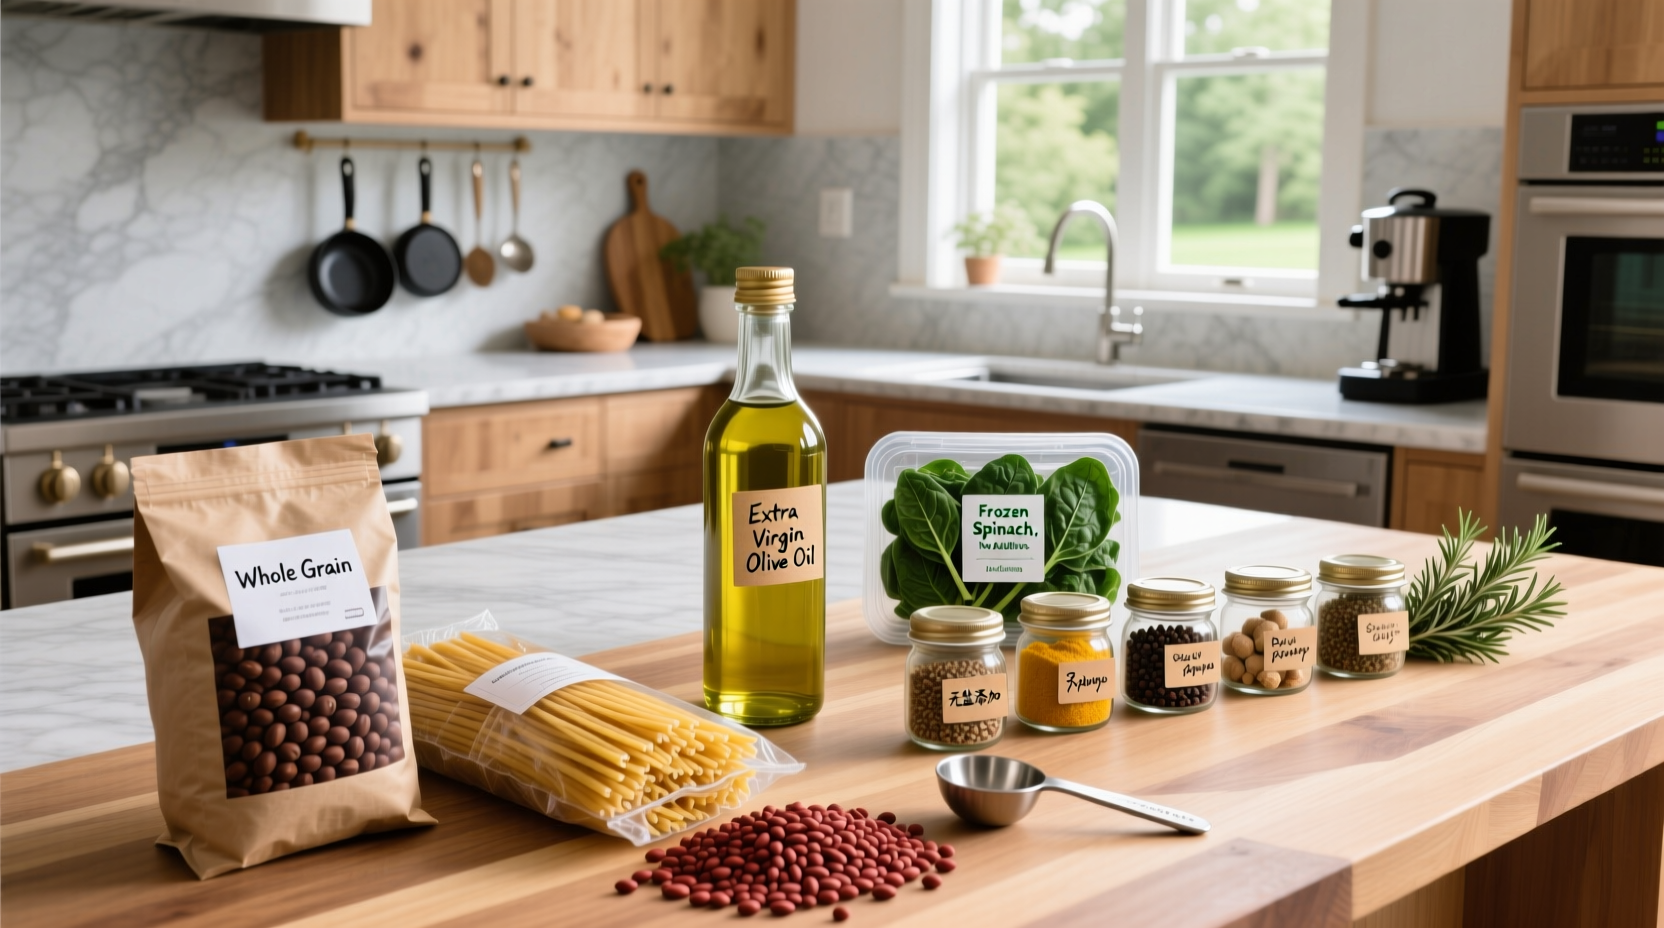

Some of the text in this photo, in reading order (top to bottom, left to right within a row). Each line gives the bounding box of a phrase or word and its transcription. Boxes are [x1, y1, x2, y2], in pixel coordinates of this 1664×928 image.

[748, 502, 798, 525] Extra
[979, 504, 1029, 518] Frozen
[752, 526, 804, 554] Virgin
[972, 520, 1039, 540] Spinach,
[746, 544, 815, 573] Olive Oil
[234, 557, 353, 589] Whole Grain
